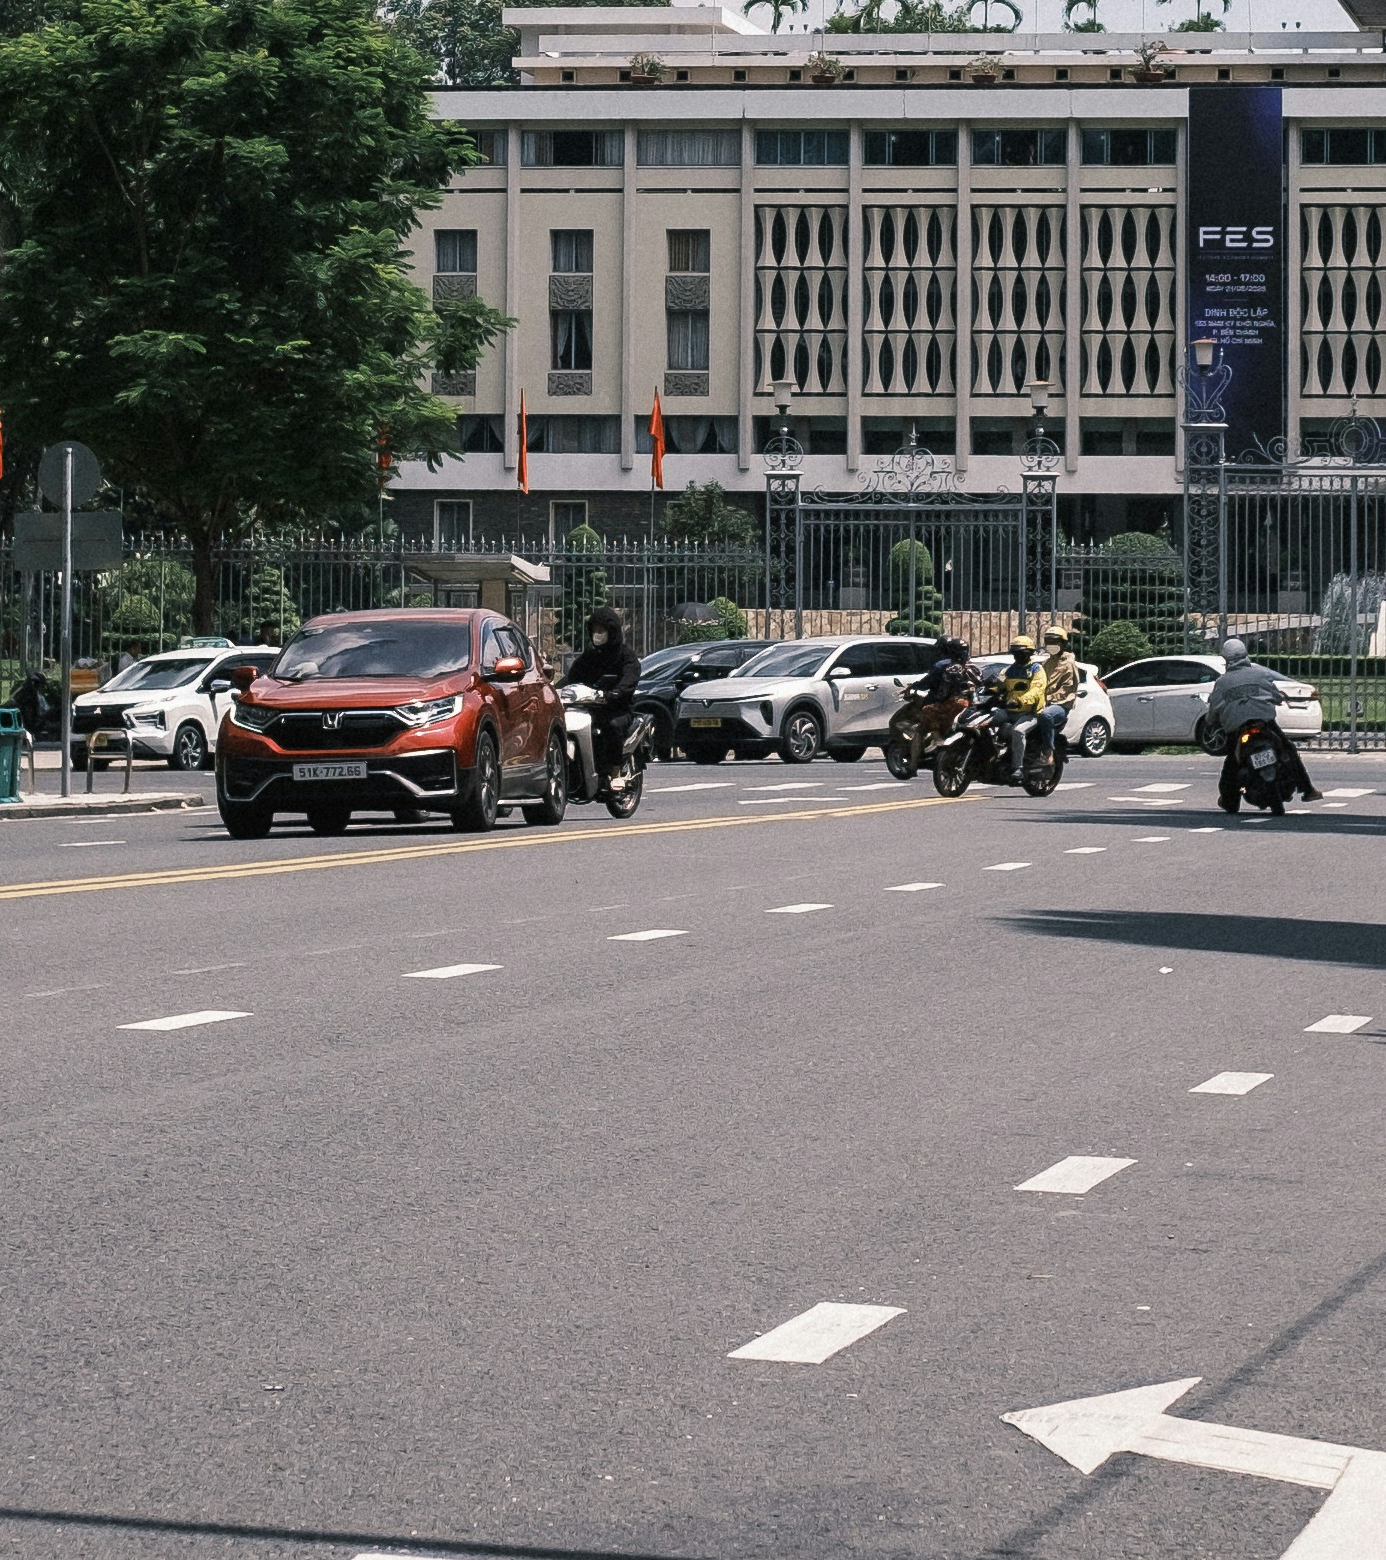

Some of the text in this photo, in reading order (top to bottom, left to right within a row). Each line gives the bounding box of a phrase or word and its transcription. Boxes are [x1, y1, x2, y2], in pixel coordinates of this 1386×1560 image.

[1199, 226, 1274, 248] FES
[1205, 273, 1266, 283] 14:00 17:00
